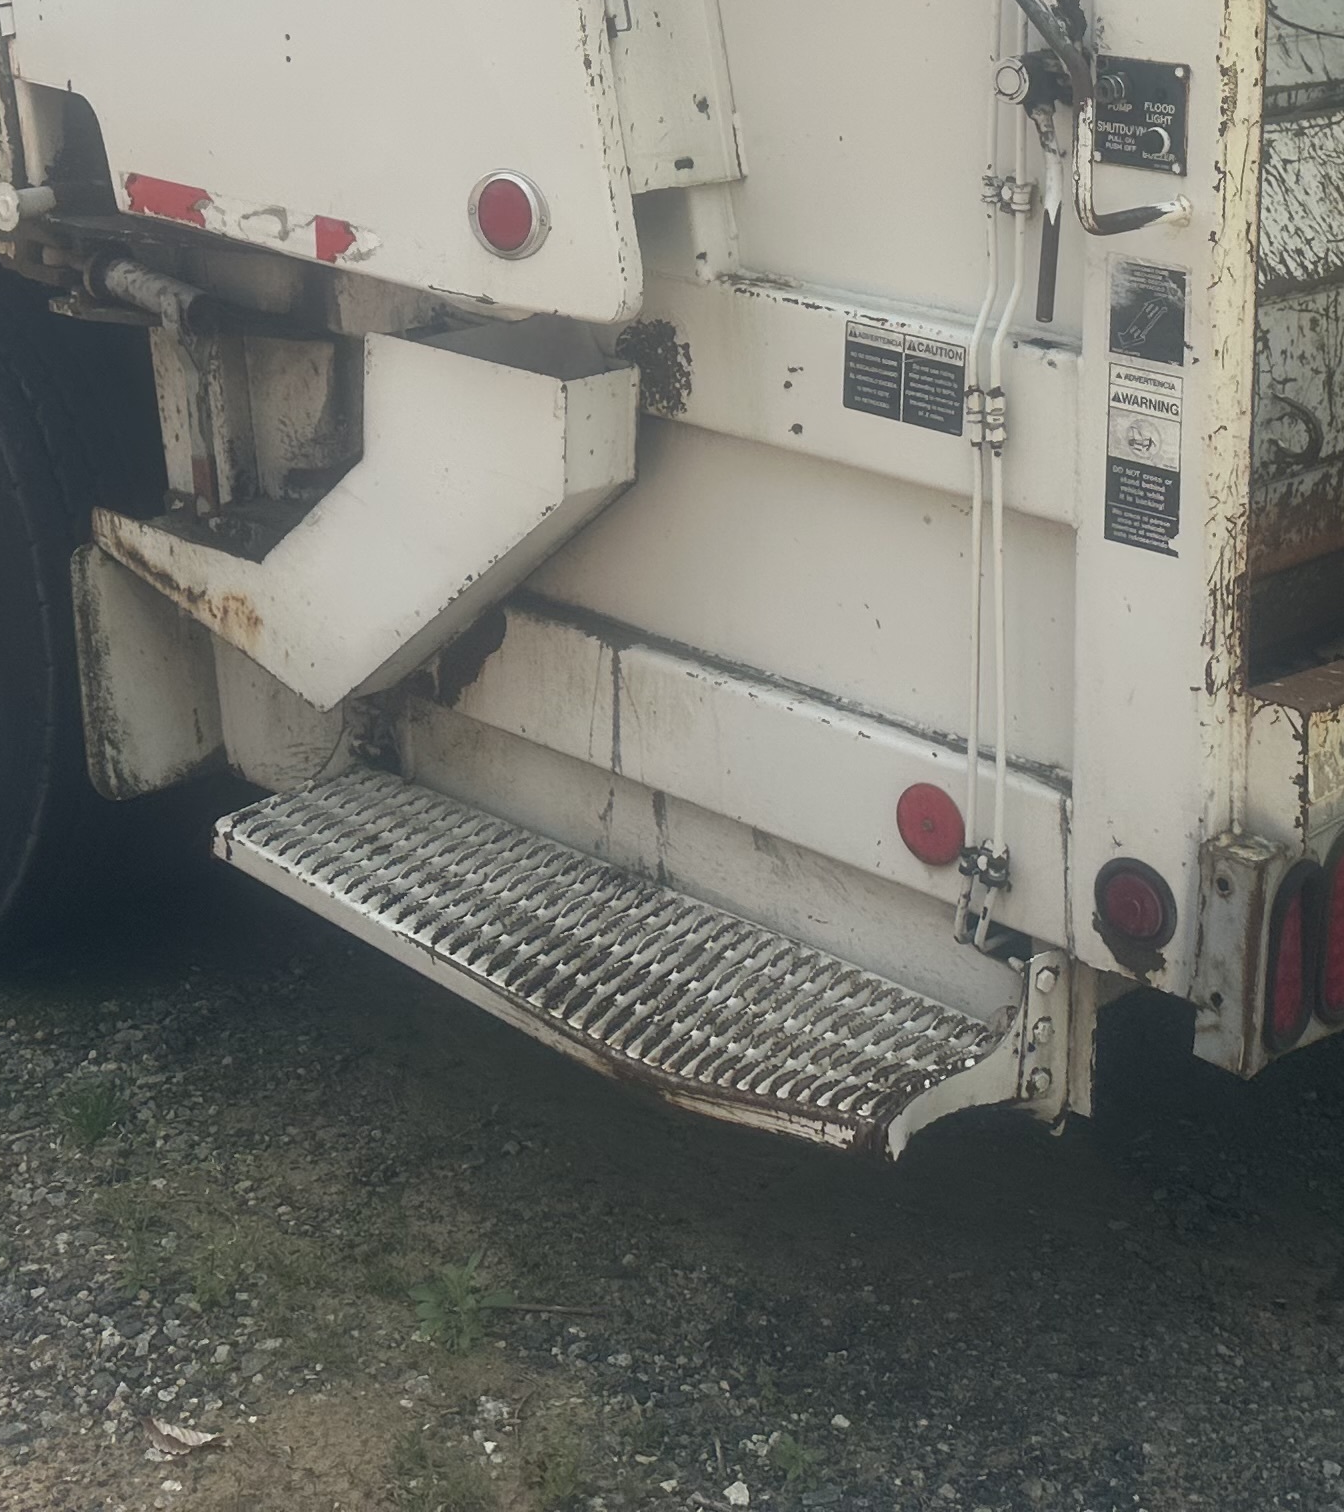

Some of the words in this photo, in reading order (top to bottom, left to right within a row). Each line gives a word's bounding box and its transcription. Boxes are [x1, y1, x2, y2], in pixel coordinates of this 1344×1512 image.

[1144, 102, 1176, 114] FLOOD
[1146, 114, 1172, 125] LIGHT
[917, 342, 963, 362] CAUTION
[1124, 373, 1176, 390] ADVERTENCIA
[1121, 392, 1179, 416] WARNING
[1126, 468, 1140, 477] NOT
